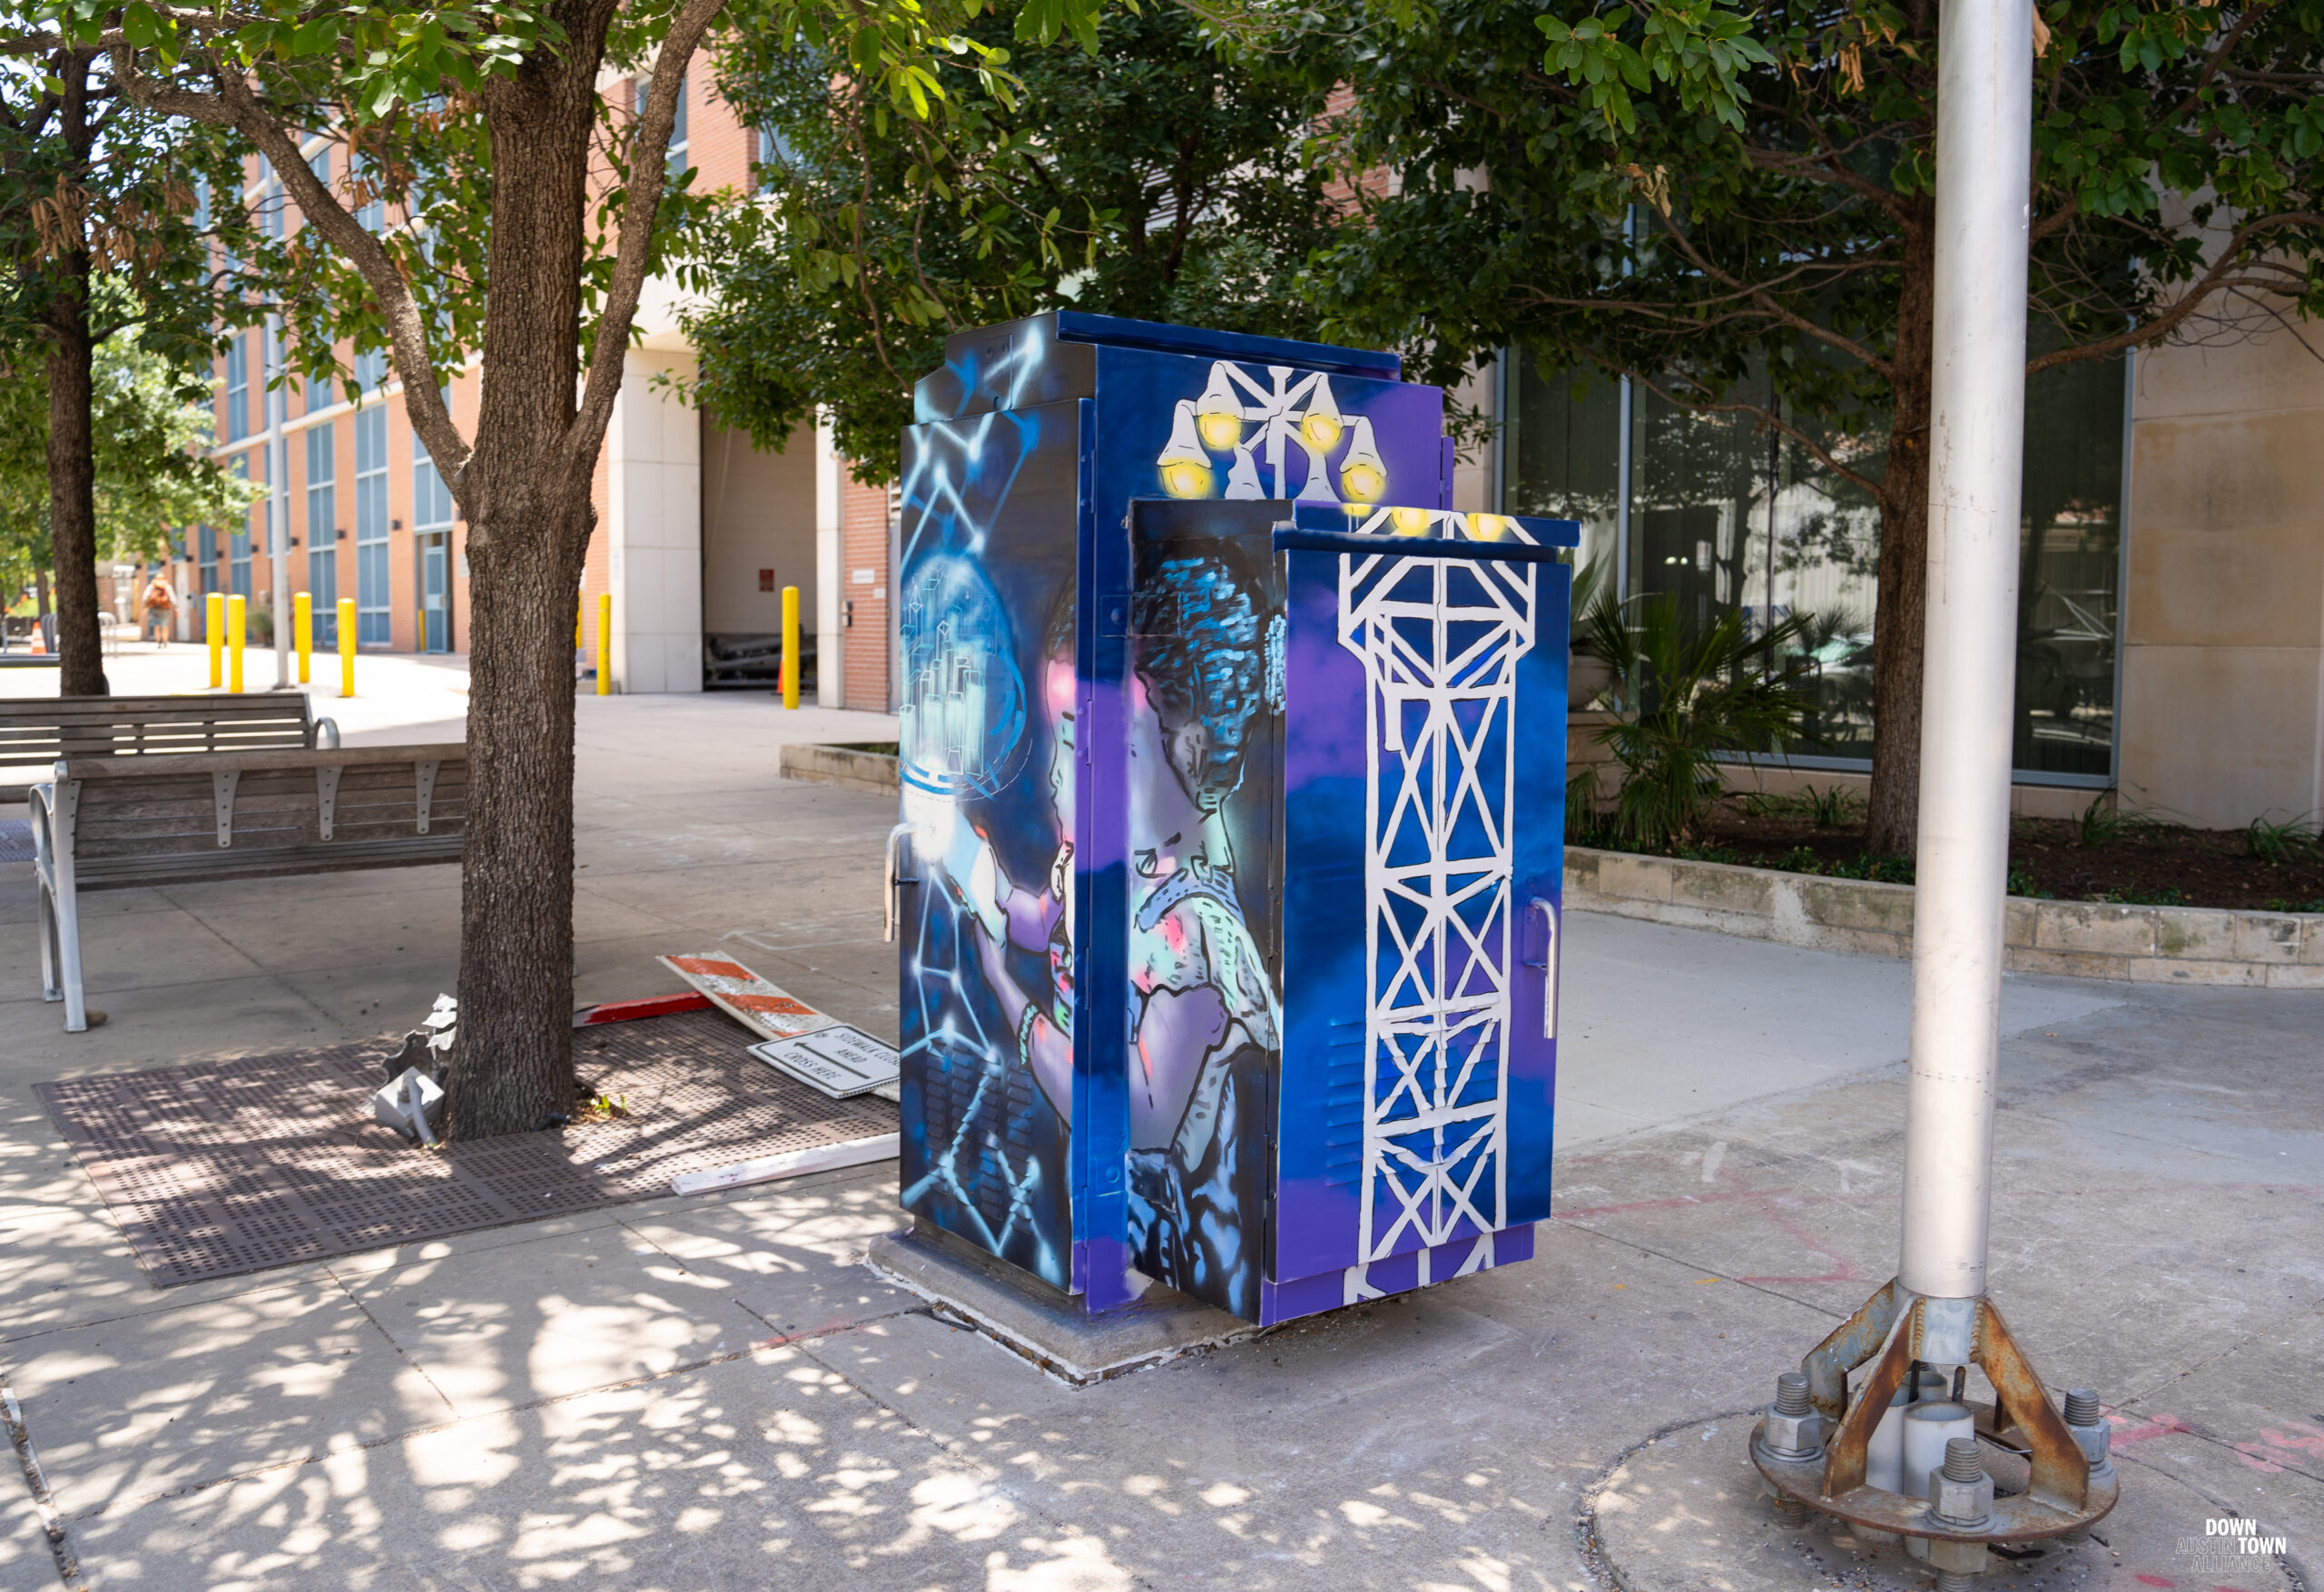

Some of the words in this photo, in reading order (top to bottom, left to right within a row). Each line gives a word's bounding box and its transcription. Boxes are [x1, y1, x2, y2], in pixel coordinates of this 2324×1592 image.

[784, 1052, 818, 1068] CROSS
[812, 1065, 842, 1080] HERE
[834, 1048, 868, 1063] AHEAD
